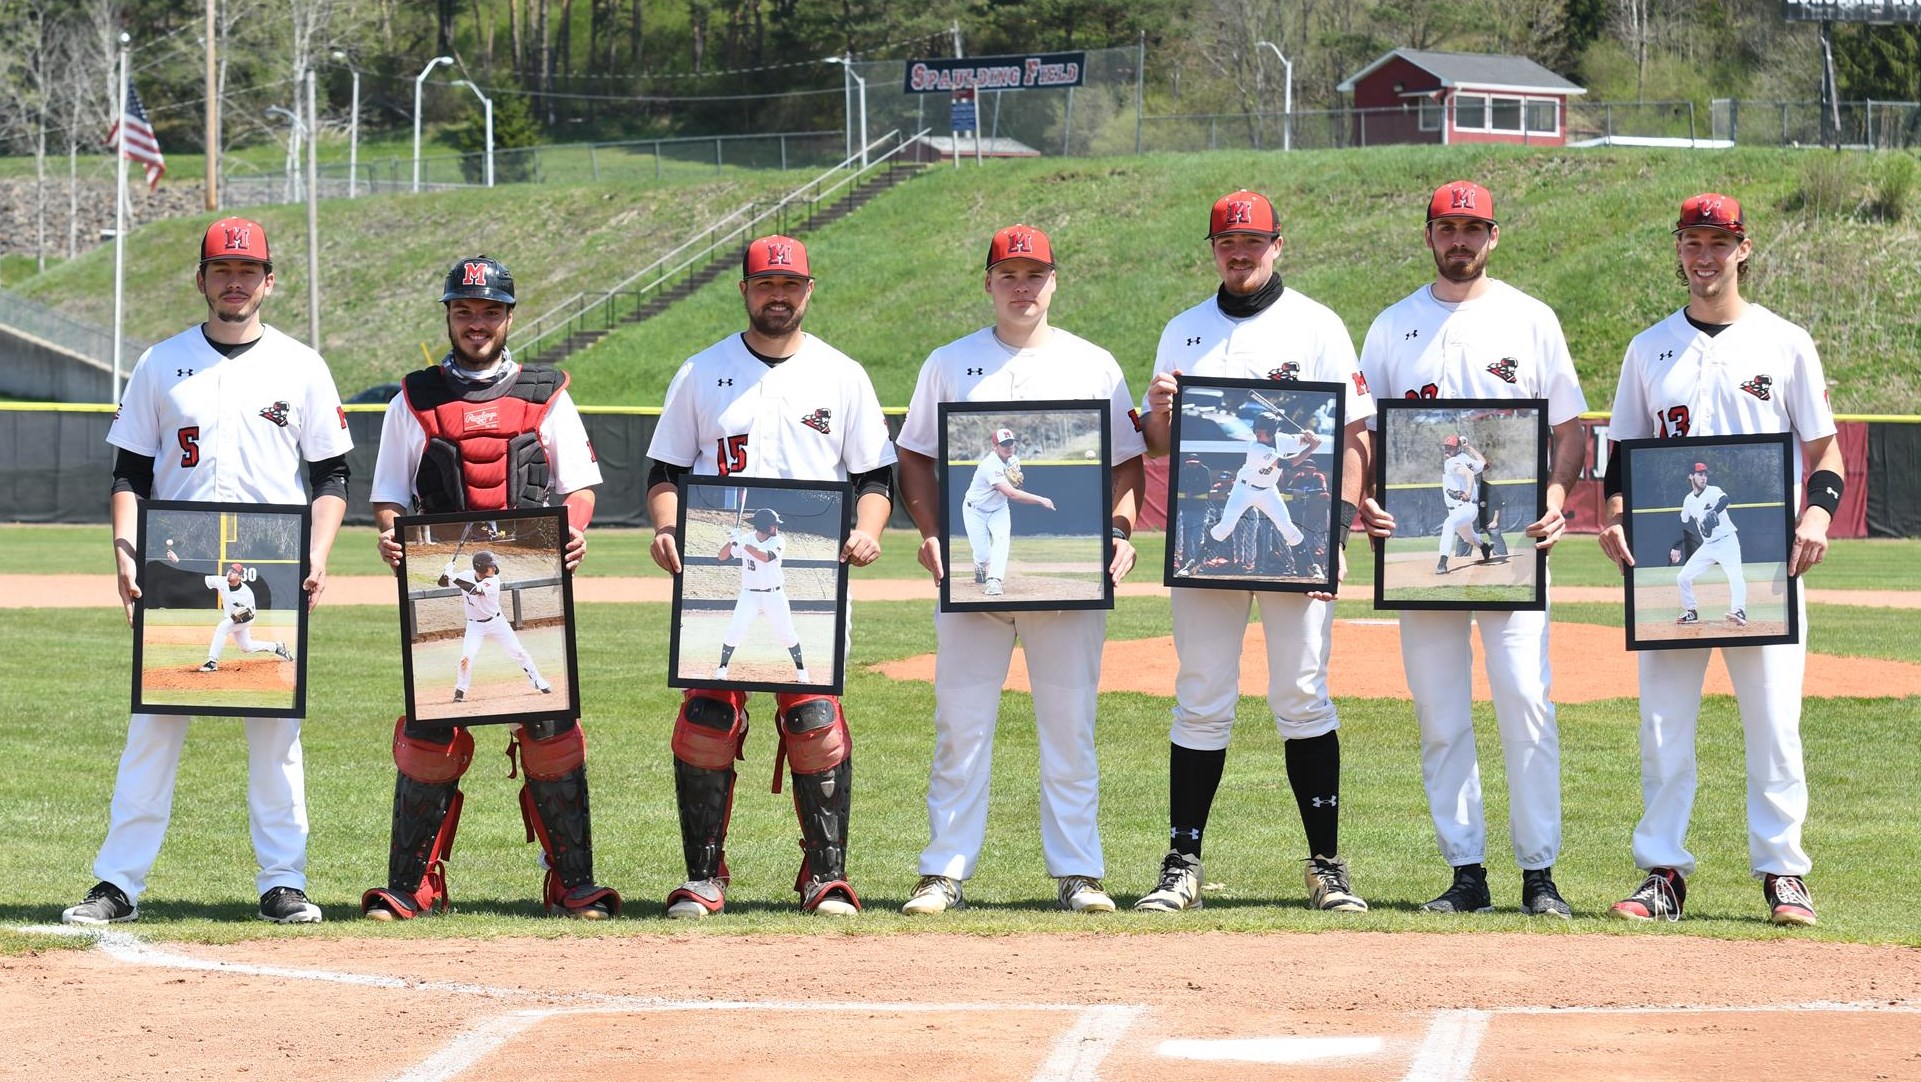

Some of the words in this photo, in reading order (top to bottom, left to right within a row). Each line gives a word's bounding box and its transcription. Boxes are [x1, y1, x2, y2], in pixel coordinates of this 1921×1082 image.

[911, 63, 1021, 90] SPAULDING
[1023, 58, 1079, 86] FIELD
[1451, 187, 1475, 209] M
[1227, 201, 1252, 224] M
[225, 227, 250, 250] M
[1008, 232, 1032, 254] M
[767, 242, 792, 266] M
[463, 263, 487, 285] M
[178, 426, 200, 468] 5
[717, 433, 748, 477] 15
